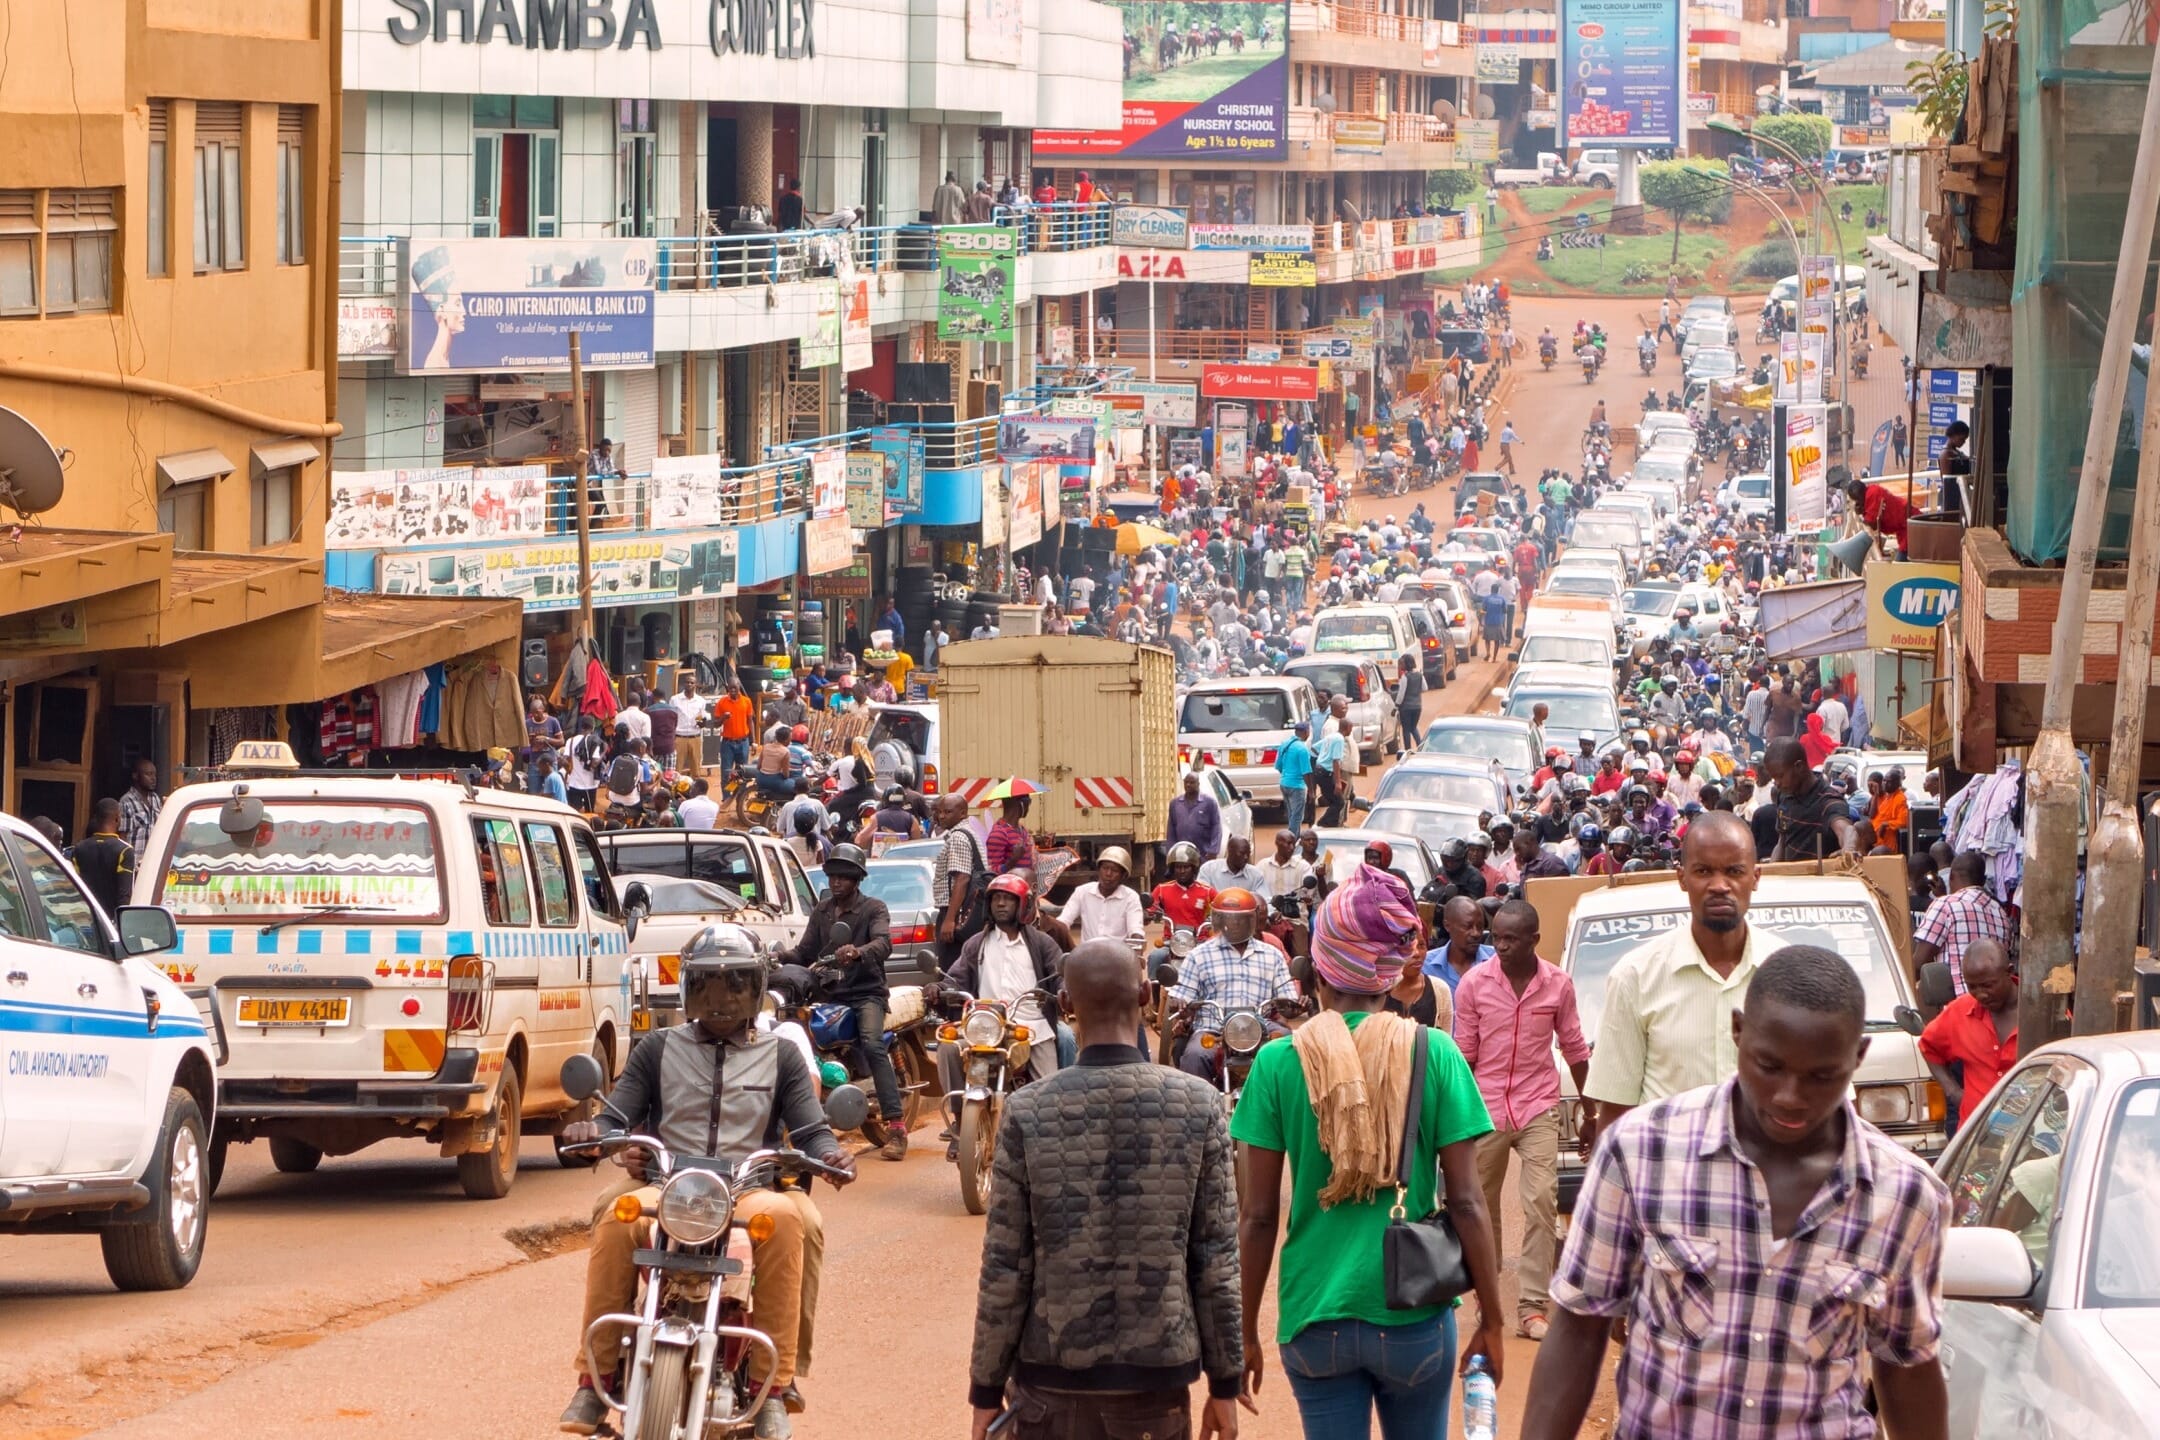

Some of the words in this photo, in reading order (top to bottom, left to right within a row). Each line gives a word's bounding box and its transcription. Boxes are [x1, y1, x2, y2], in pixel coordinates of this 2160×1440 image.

[387, 0, 662, 51] SHAMBA
[709, 0, 817, 59] COMPLEX
[1218, 104, 1273, 116] CHRISTIAN
[1184, 119, 1232, 130] NURSERY
[1234, 120, 1276, 132] SCHOOL
[1186, 135, 1206, 149] Age
[1227, 136, 1238, 147] to
[1115, 219, 1136, 234] DRY
[1139, 220, 1185, 236] CLEANER
[1192, 224, 1234, 233] TRIPLEX
[953, 232, 1013, 250] BOB
[1263, 252, 1302, 260] QUALITY
[1118, 255, 1186, 279] AZA
[1251, 260, 1295, 268] PLASTIC
[468, 297, 503, 317] CAIRO
[505, 296, 592, 316] INTERNATIONAL
[595, 297, 625, 315] BANK
[627, 296, 647, 314] LTD
[515, 325, 521, 333] a
[521, 322, 536, 333] solid
[586, 321, 595, 332] the
[549, 356, 570, 365] COMPLE
[1236, 374, 1252, 384] itel
[1932, 378, 1952, 386] PROJECT
[1066, 402, 1106, 414] BOB
[590, 543, 664, 562] SOUNDS
[512, 566, 546, 576] Suppliers
[549, 566, 556, 574] of
[557, 565, 566, 573] All
[592, 562, 620, 571] Systems
[1899, 587, 1958, 616] MTN
[1891, 634, 1927, 646] Mobile
[241, 744, 281, 759] TAXI
[1584, 911, 1691, 938] ARSEN
[156, 963, 199, 982] AY
[257, 1002, 289, 1020] UAY
[299, 1001, 341, 1020] 441H
[9, 1050, 29, 1075] CIVIL
[30, 1051, 67, 1077] AVIATION
[67, 1053, 109, 1078] AUTHORITY
